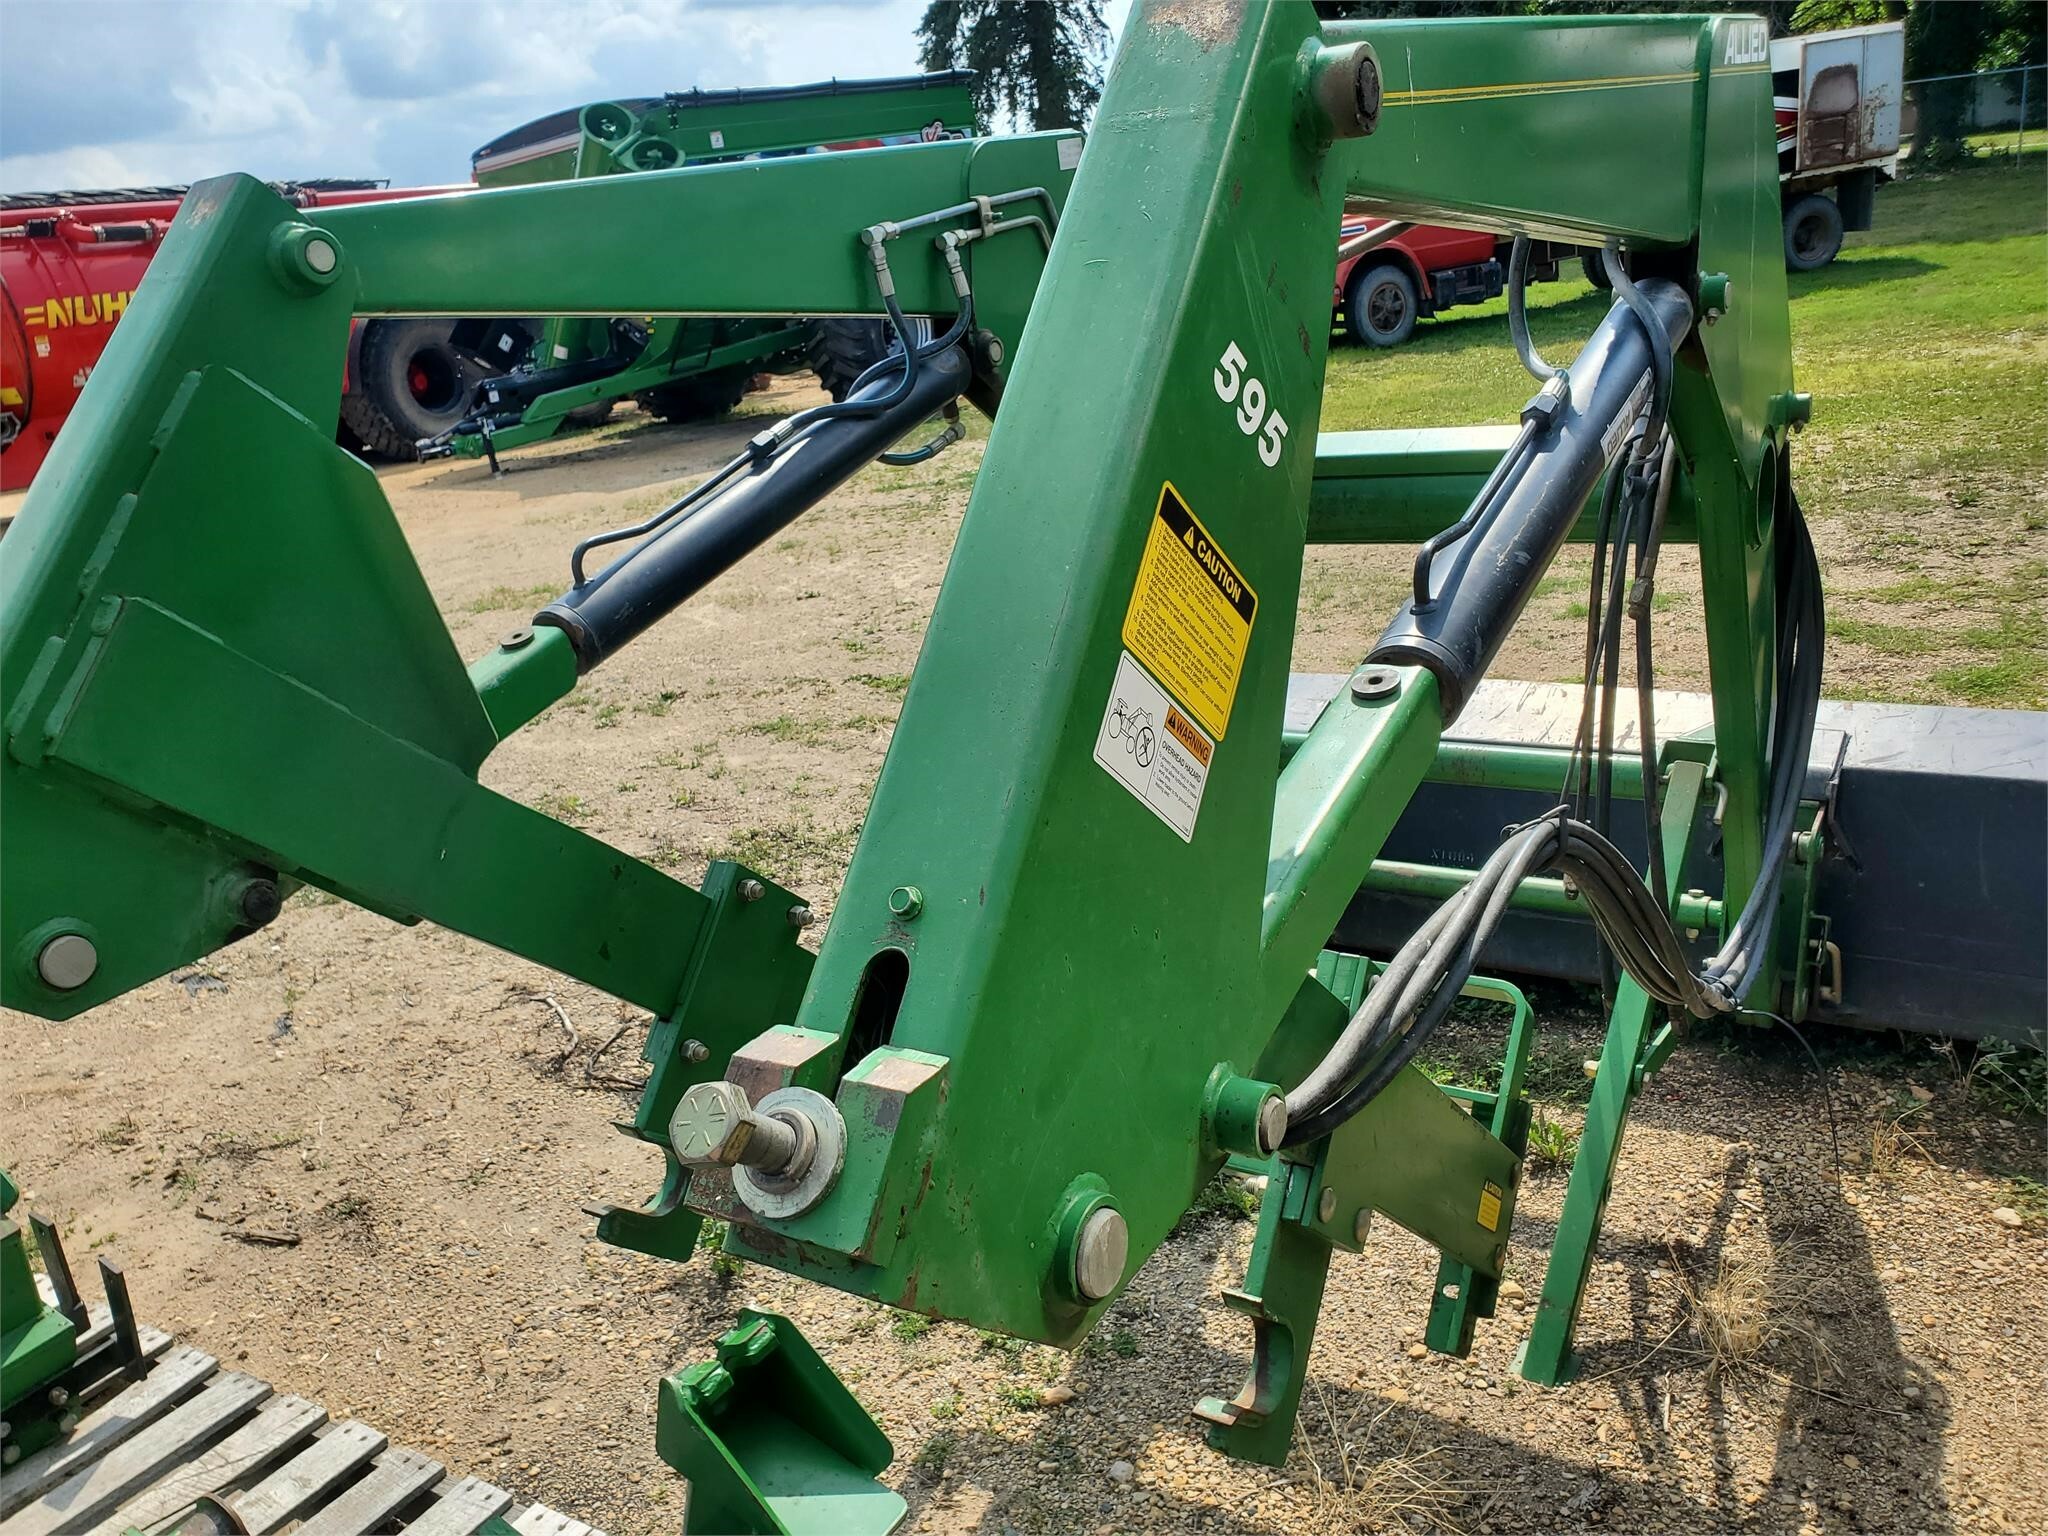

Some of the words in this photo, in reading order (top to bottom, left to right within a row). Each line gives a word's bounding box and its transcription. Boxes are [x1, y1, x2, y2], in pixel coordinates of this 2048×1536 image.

[1724, 23, 1767, 64] ALLIED
[46, 289, 136, 329] NUH
[1214, 340, 1289, 467] 595
[1197, 539, 1241, 604] CAUTION
[1162, 740, 1184, 767] OVERHEAD
[1184, 763, 1201, 783] HAZARD
[1176, 722, 1209, 761] WARNING
